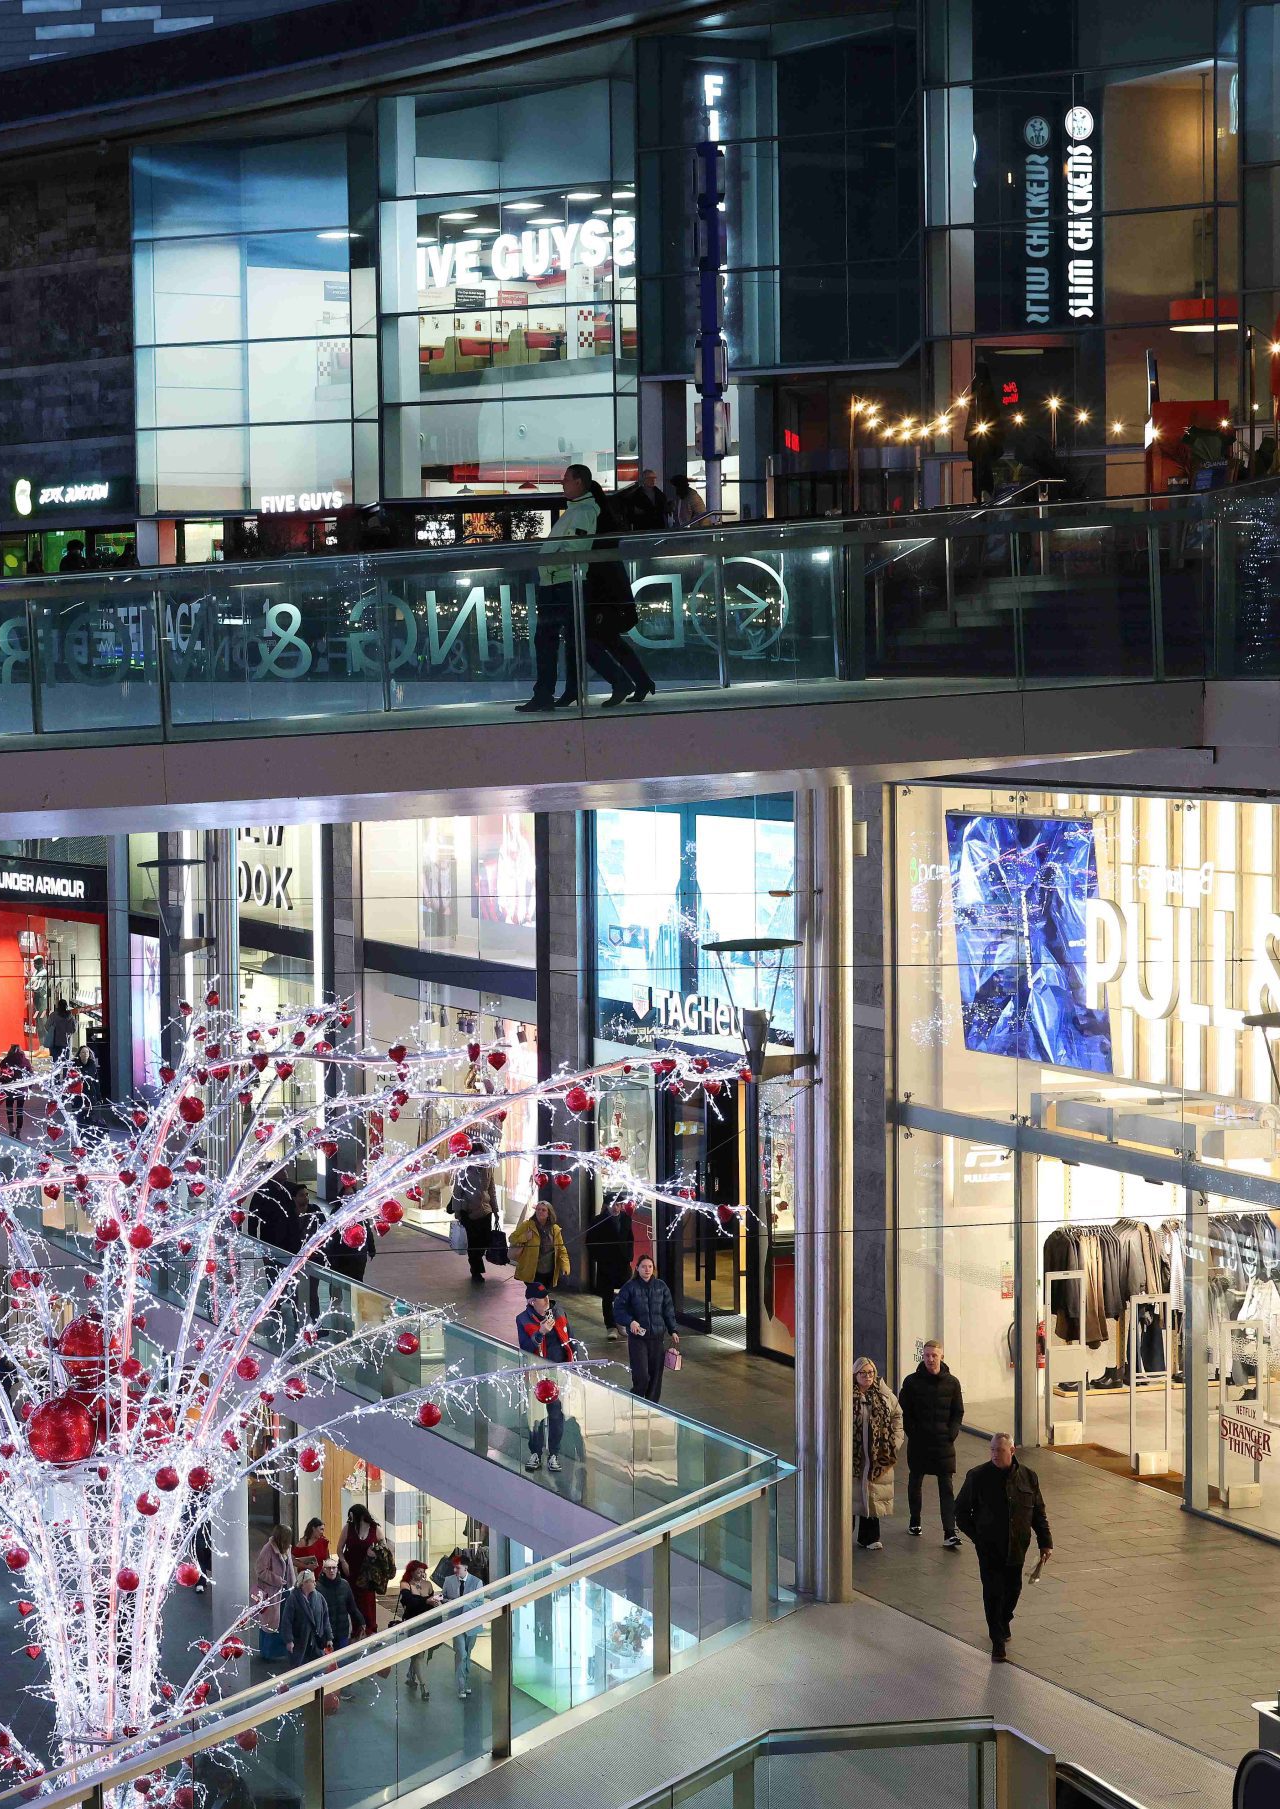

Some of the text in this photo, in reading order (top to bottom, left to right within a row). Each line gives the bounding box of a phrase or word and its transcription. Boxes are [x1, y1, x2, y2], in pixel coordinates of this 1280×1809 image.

[1067, 144, 1094, 318] SLIM CHICKENS
[417, 218, 610, 290] IVE GUYS
[260, 490, 343, 514] FIVE GUYS
[35, 874, 85, 899] ARMOUR
[237, 860, 293, 911] OOK
[1235, 1404, 1257, 1420] NETFLIX
[1221, 1418, 1271, 1454] STRANGER
[1228, 1436, 1264, 1463] THINGS
